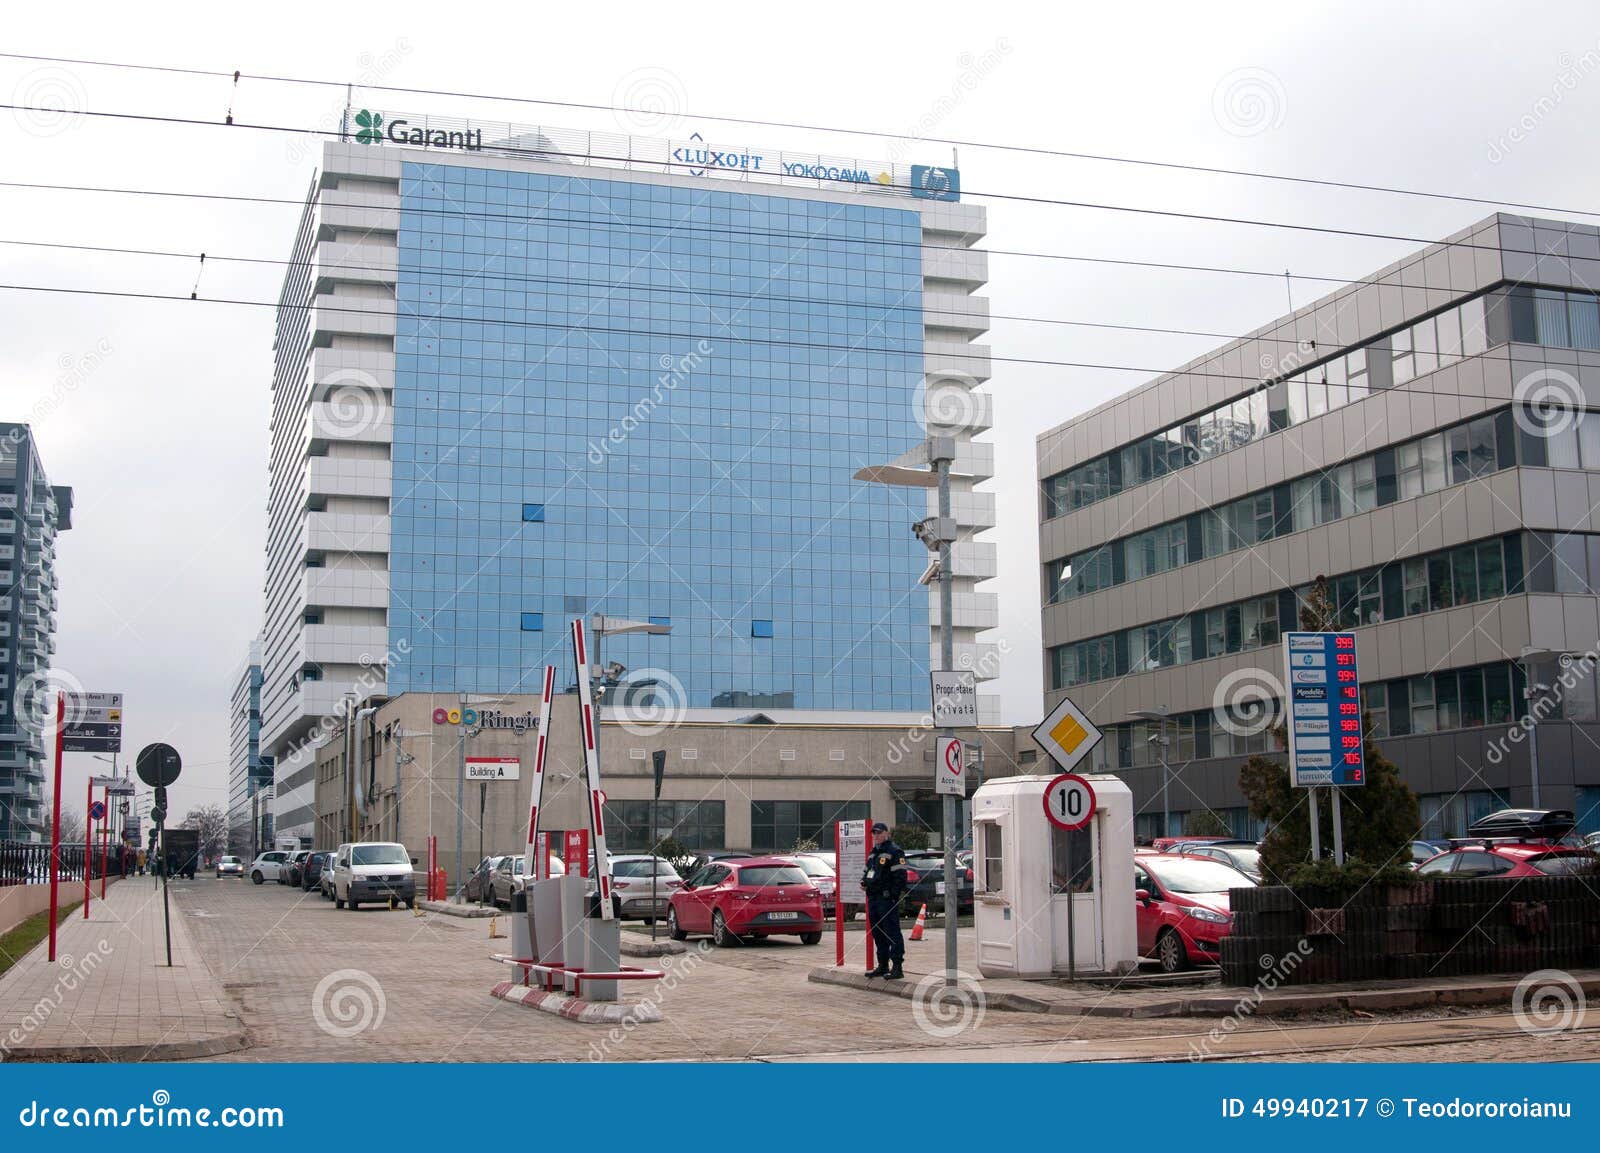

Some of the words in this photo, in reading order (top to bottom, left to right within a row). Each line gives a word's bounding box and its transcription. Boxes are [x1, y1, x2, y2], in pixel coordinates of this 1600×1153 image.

[387, 119, 481, 151] Garanti
[685, 148, 763, 170] LUXOFT
[783, 162, 872, 184] YOKOGAWA
[1336, 638, 1353, 648] 999
[1337, 654, 1354, 665] 997
[1338, 670, 1355, 681] 994
[1344, 687, 1357, 698] 40
[1340, 703, 1358, 714] 999
[480, 710, 541, 736] Ringie
[1341, 720, 1359, 731] 989
[1342, 736, 1360, 748] 999
[469, 766, 497, 778] Building
[497, 767, 505, 777] A
[1354, 769, 1361, 780] 2
[1059, 788, 1082, 816] 10
